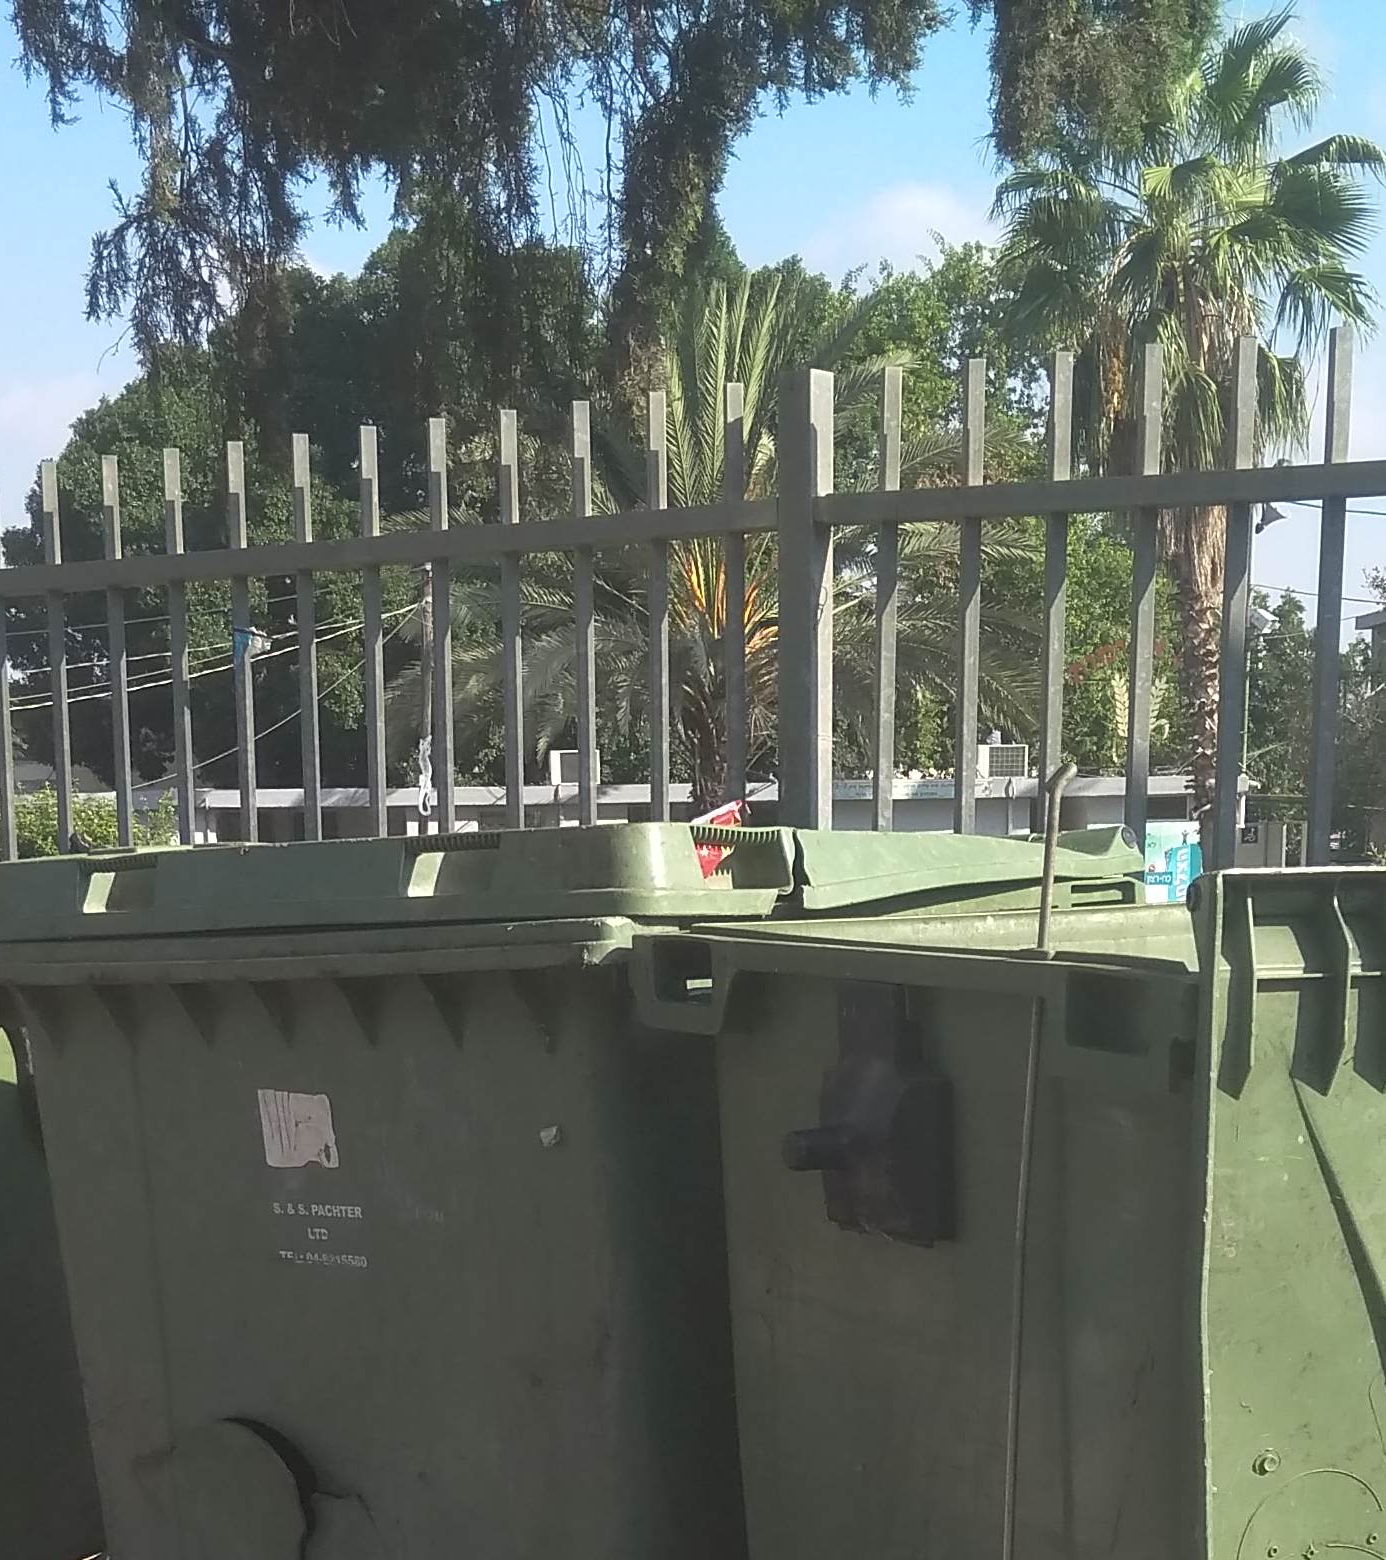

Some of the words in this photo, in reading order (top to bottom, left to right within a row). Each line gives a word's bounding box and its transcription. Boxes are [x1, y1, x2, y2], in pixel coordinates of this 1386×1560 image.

[273, 1202, 284, 1214] S.
[287, 1203, 296, 1215] &
[297, 1203, 309, 1215] S.
[311, 1204, 363, 1219] PACHTER
[307, 1227, 329, 1240] LTD
